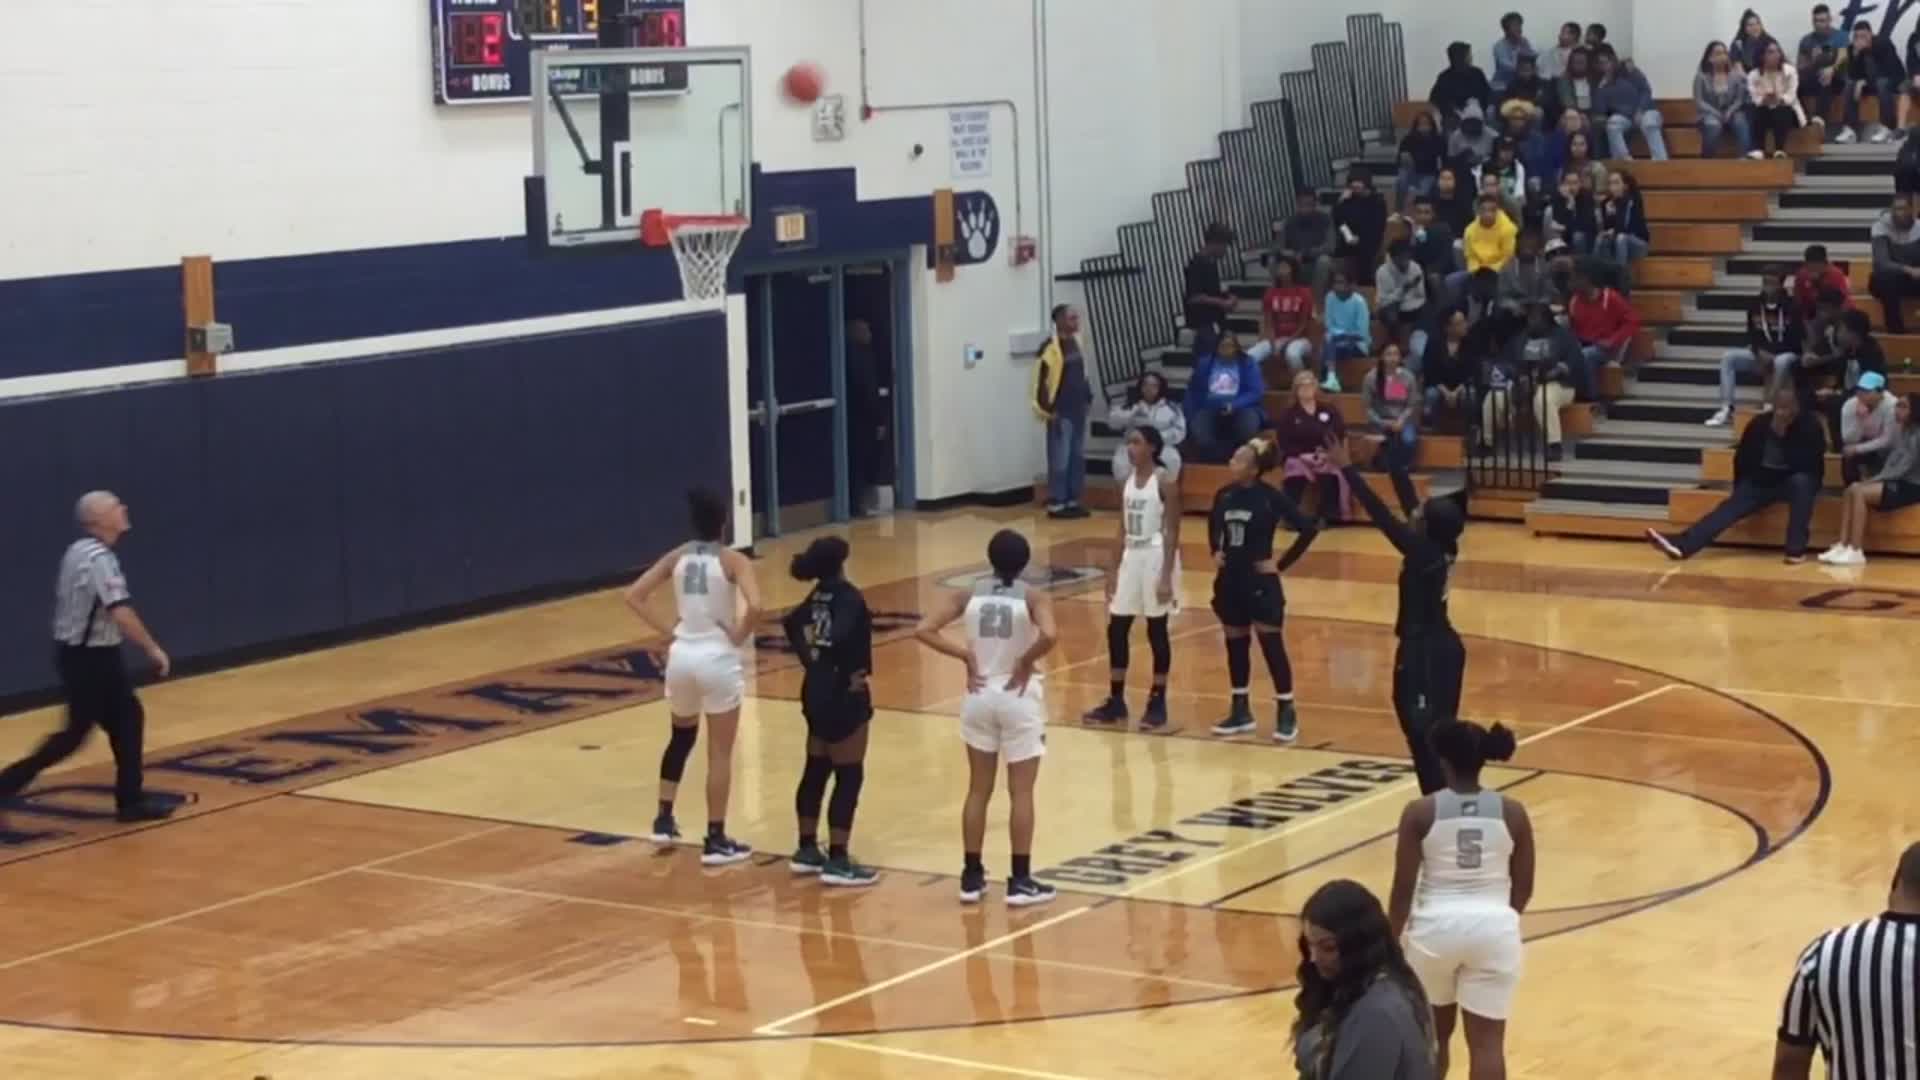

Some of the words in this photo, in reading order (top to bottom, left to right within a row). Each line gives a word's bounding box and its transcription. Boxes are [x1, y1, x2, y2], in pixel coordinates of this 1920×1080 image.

[471, 73, 511, 92] BONUS
[684, 562, 708, 594] 21
[979, 603, 1013, 639] 23
[1033, 829, 1225, 887] GREY
[1177, 759, 1416, 831] WOLVES
[1456, 829, 1483, 868] 5
